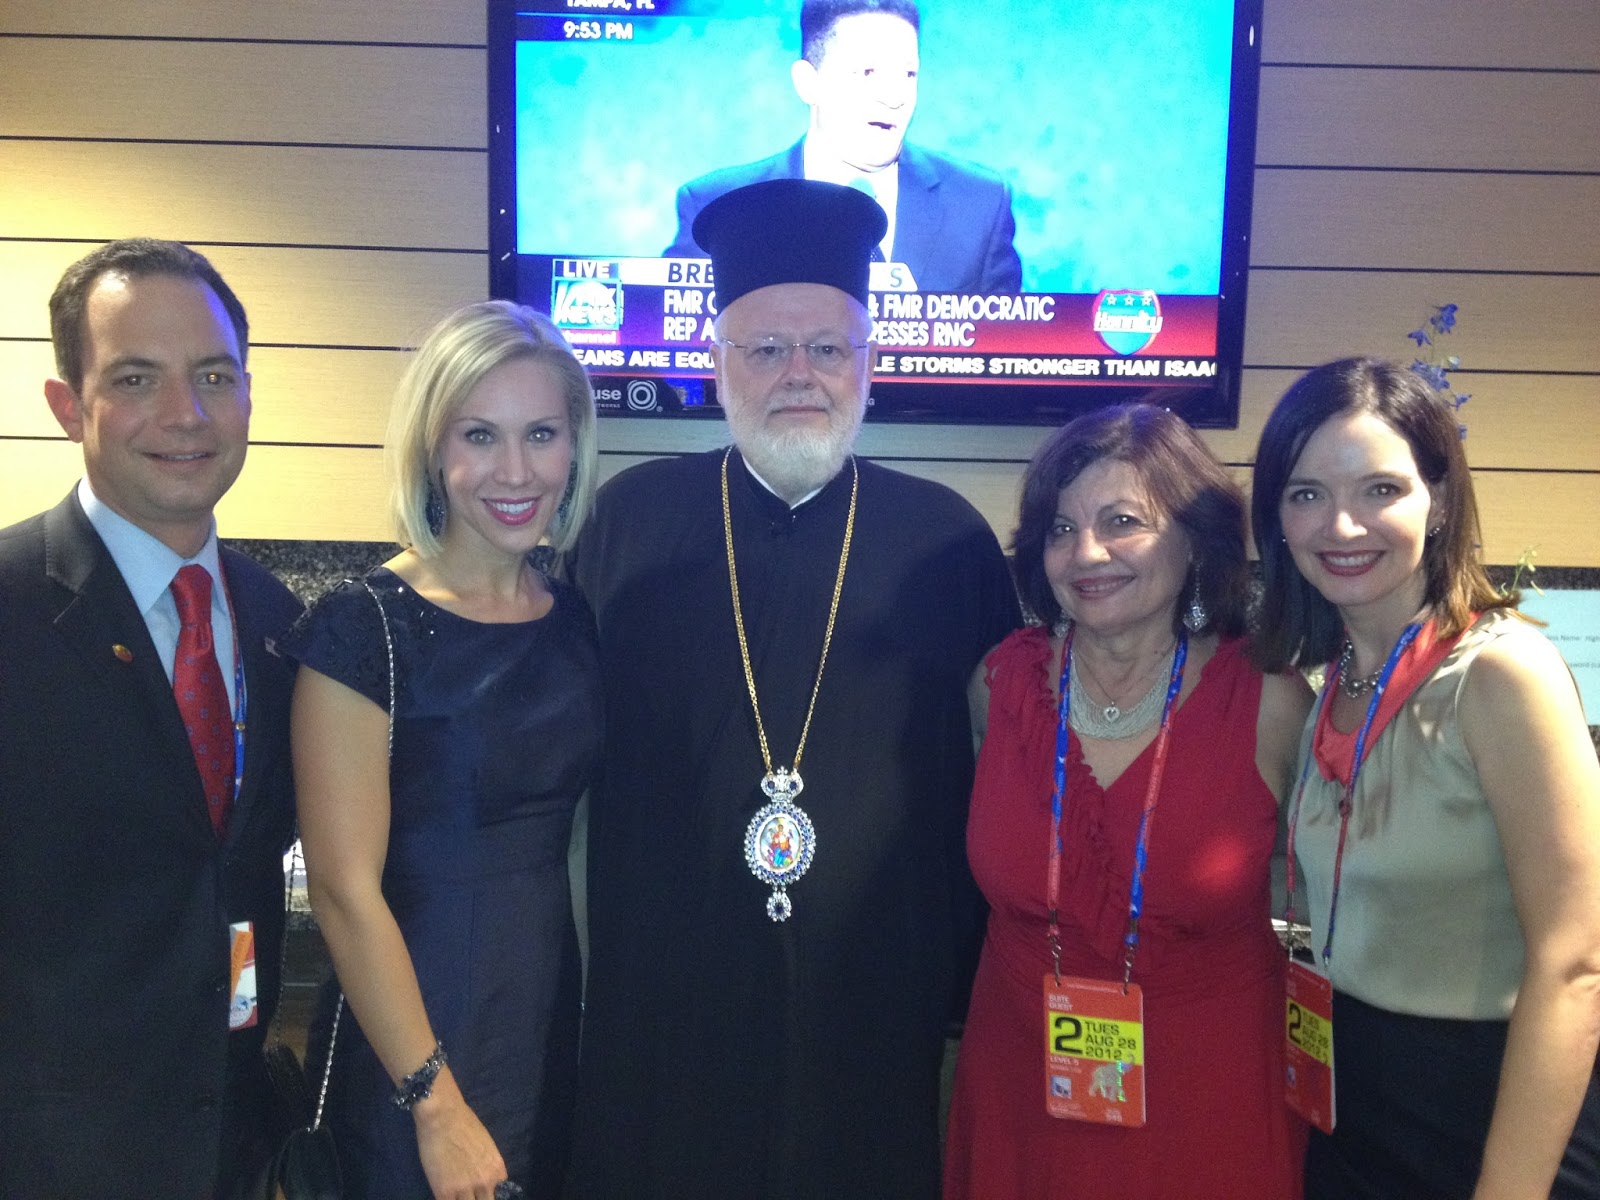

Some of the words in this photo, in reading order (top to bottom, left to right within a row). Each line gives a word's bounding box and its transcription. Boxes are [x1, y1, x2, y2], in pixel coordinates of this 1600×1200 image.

[563, 20, 602, 39] 9:53
[605, 22, 633, 40] PM
[563, 260, 611, 279] LIVE
[663, 289, 703, 315] FMR
[883, 294, 923, 320] FMR
[927, 294, 1055, 322] DEMOCRATIC
[663, 316, 698, 341] REP
[933, 321, 976, 347] RNC
[628, 350, 671, 368] ARE
[899, 356, 985, 374] STORMS
[988, 357, 1101, 376] STRONGER
[1104, 359, 1161, 376] THAN
[1084, 1021, 1120, 1036] TUES
[1289, 1002, 1302, 1045] 2
[1054, 1016, 1083, 1054] 2
[1085, 1034, 1114, 1048] AUG
[1117, 1038, 1136, 1050] 28
[1085, 1046, 1122, 1060] 2012
